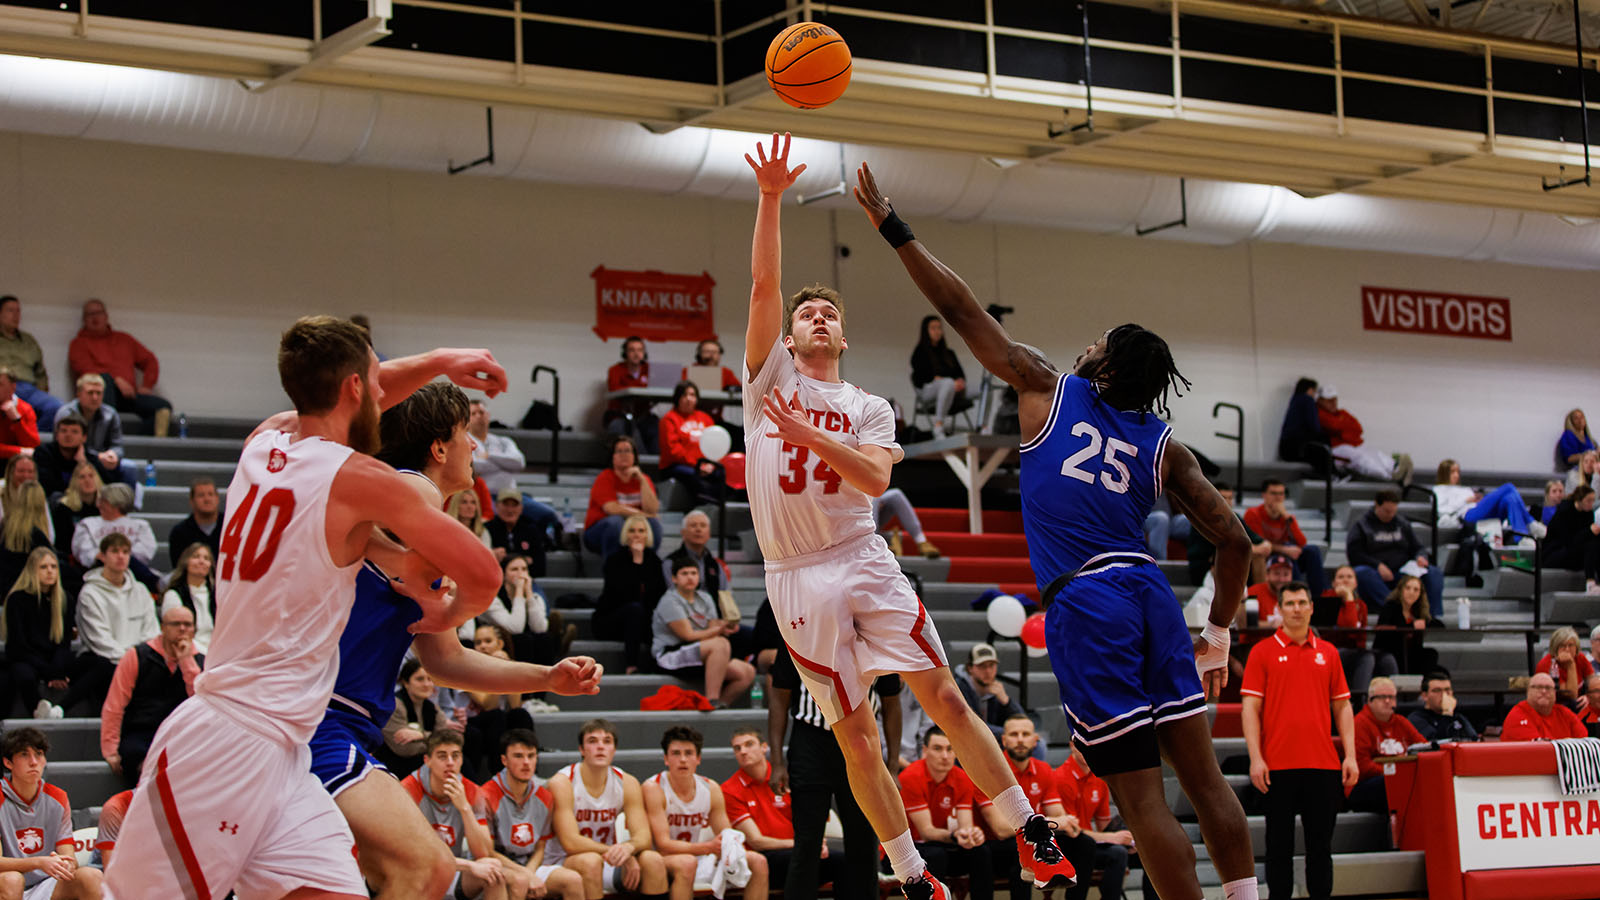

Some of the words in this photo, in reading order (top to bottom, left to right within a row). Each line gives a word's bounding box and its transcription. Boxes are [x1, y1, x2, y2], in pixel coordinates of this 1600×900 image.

[601, 287, 709, 312] KNIA/KRLS
[1366, 291, 1507, 336] VISITORS
[778, 440, 843, 495] 34
[1060, 421, 1139, 494] 25
[220, 483, 297, 583] 40
[575, 807, 617, 823] DUTCH
